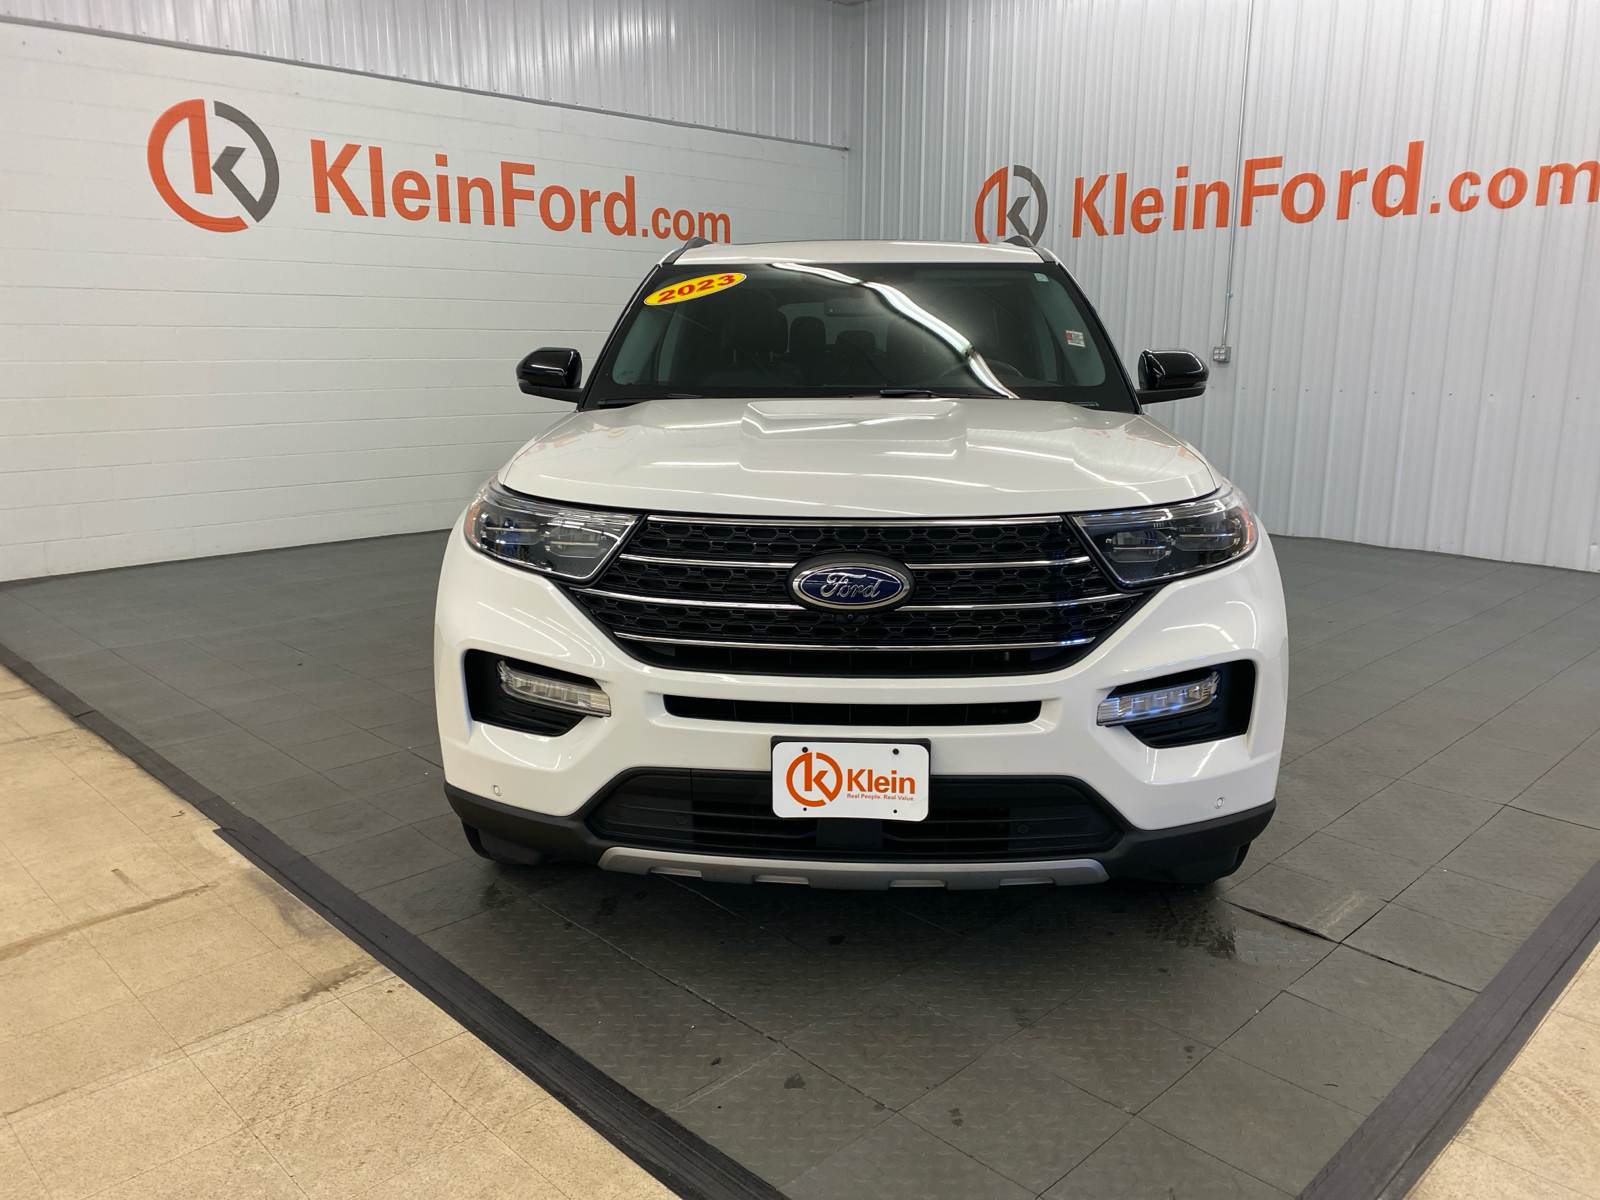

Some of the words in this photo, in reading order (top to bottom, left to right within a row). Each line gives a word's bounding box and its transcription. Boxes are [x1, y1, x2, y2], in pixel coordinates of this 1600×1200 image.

[310, 138, 730, 244] KleinFord.com
[1071, 140, 1600, 239] KleinFord.com
[658, 275, 735, 303] 2023
[820, 572, 880, 598] Ford
[847, 768, 916, 794] Klein
